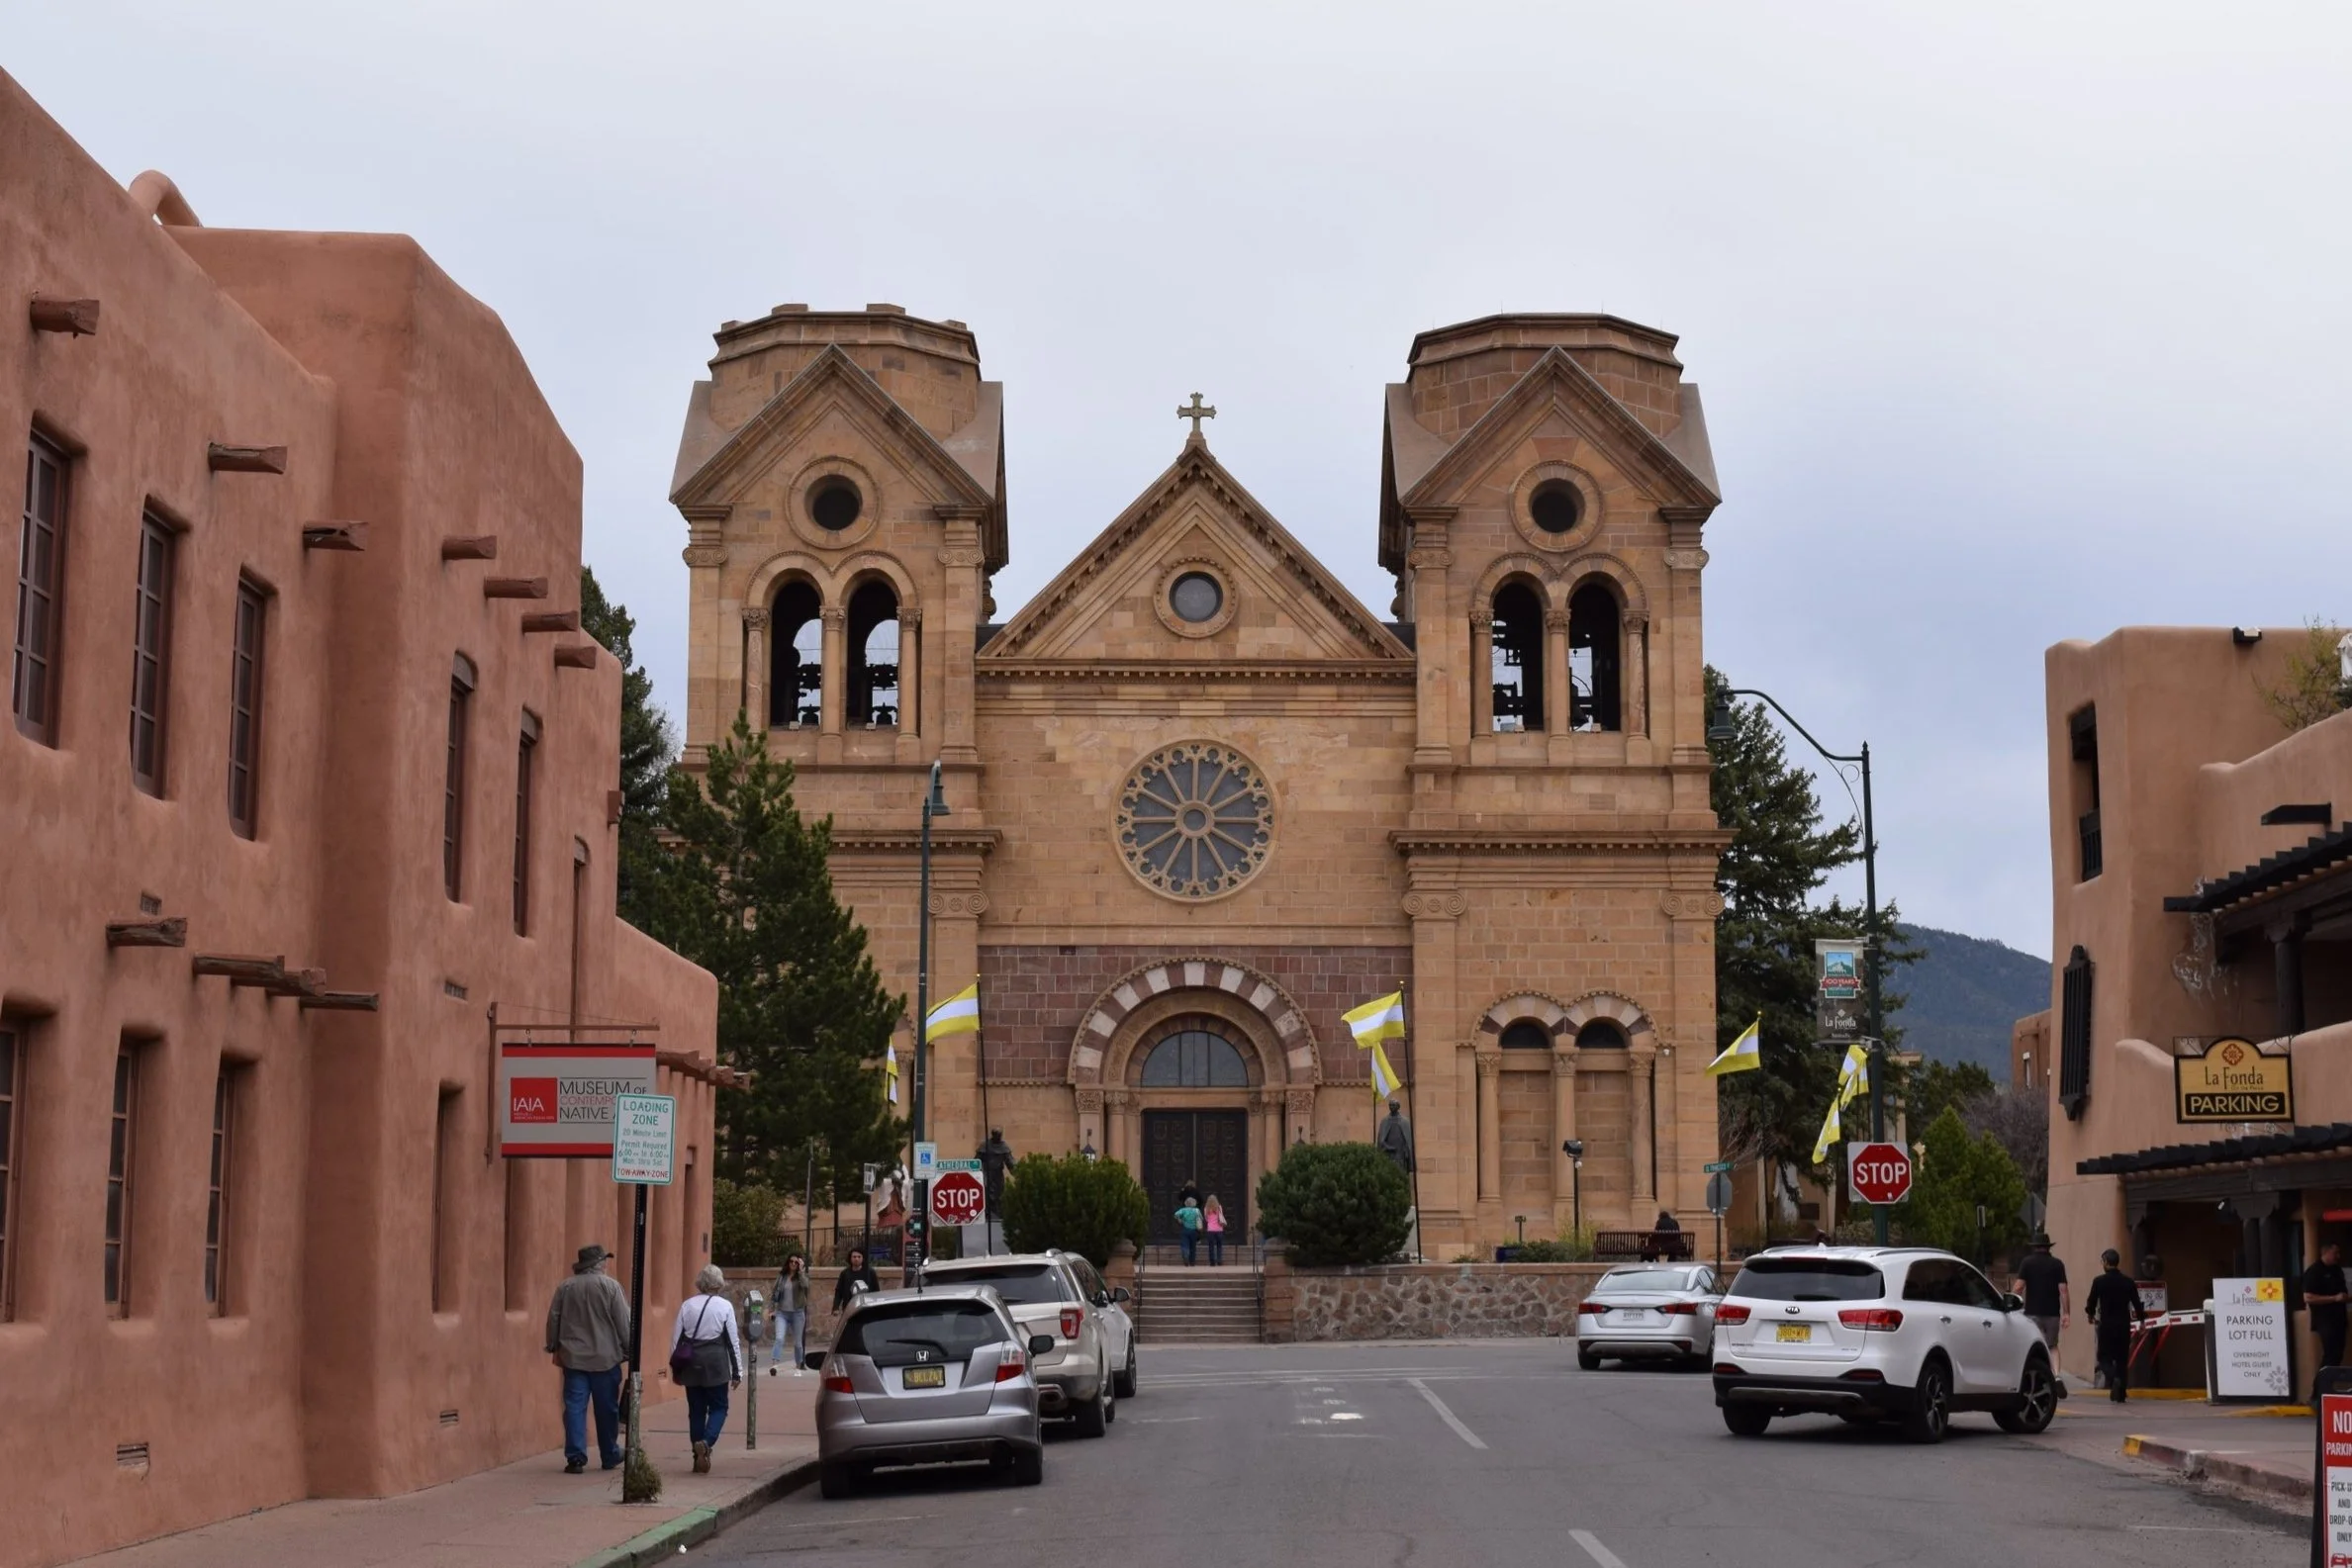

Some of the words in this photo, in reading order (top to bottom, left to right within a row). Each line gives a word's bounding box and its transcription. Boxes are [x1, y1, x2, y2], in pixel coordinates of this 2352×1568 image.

[1825, 1015, 1834, 1027] La
[1835, 1015, 1856, 1030] Fonda
[2205, 1065, 2219, 1085] La
[2222, 1065, 2264, 1089] Fonda
[559, 1080, 630, 1095] MUSEUM
[633, 1086, 648, 1095] OF
[513, 1097, 545, 1112] IAIA
[623, 1100, 669, 1114] LOADING
[2190, 1095, 2280, 1113] PARKING
[559, 1106, 609, 1120] NATIVE
[632, 1114, 659, 1126] ZONE
[621, 1140, 640, 1149] Permit
[642, 1141, 668, 1150] Required
[1856, 1162, 1907, 1184] STOP
[936, 1188, 980, 1208] STOP
[2241, 1293, 2263, 1307] Fon
[2226, 1315, 2273, 1326] PARKING
[2228, 1331, 2248, 1340] LOT
[2249, 1331, 2273, 1340] FULL
[2332, 1411, 2352, 1433] NO
[2337, 1498, 2351, 1509] AND
[2336, 1531, 2352, 1543] ONLY
